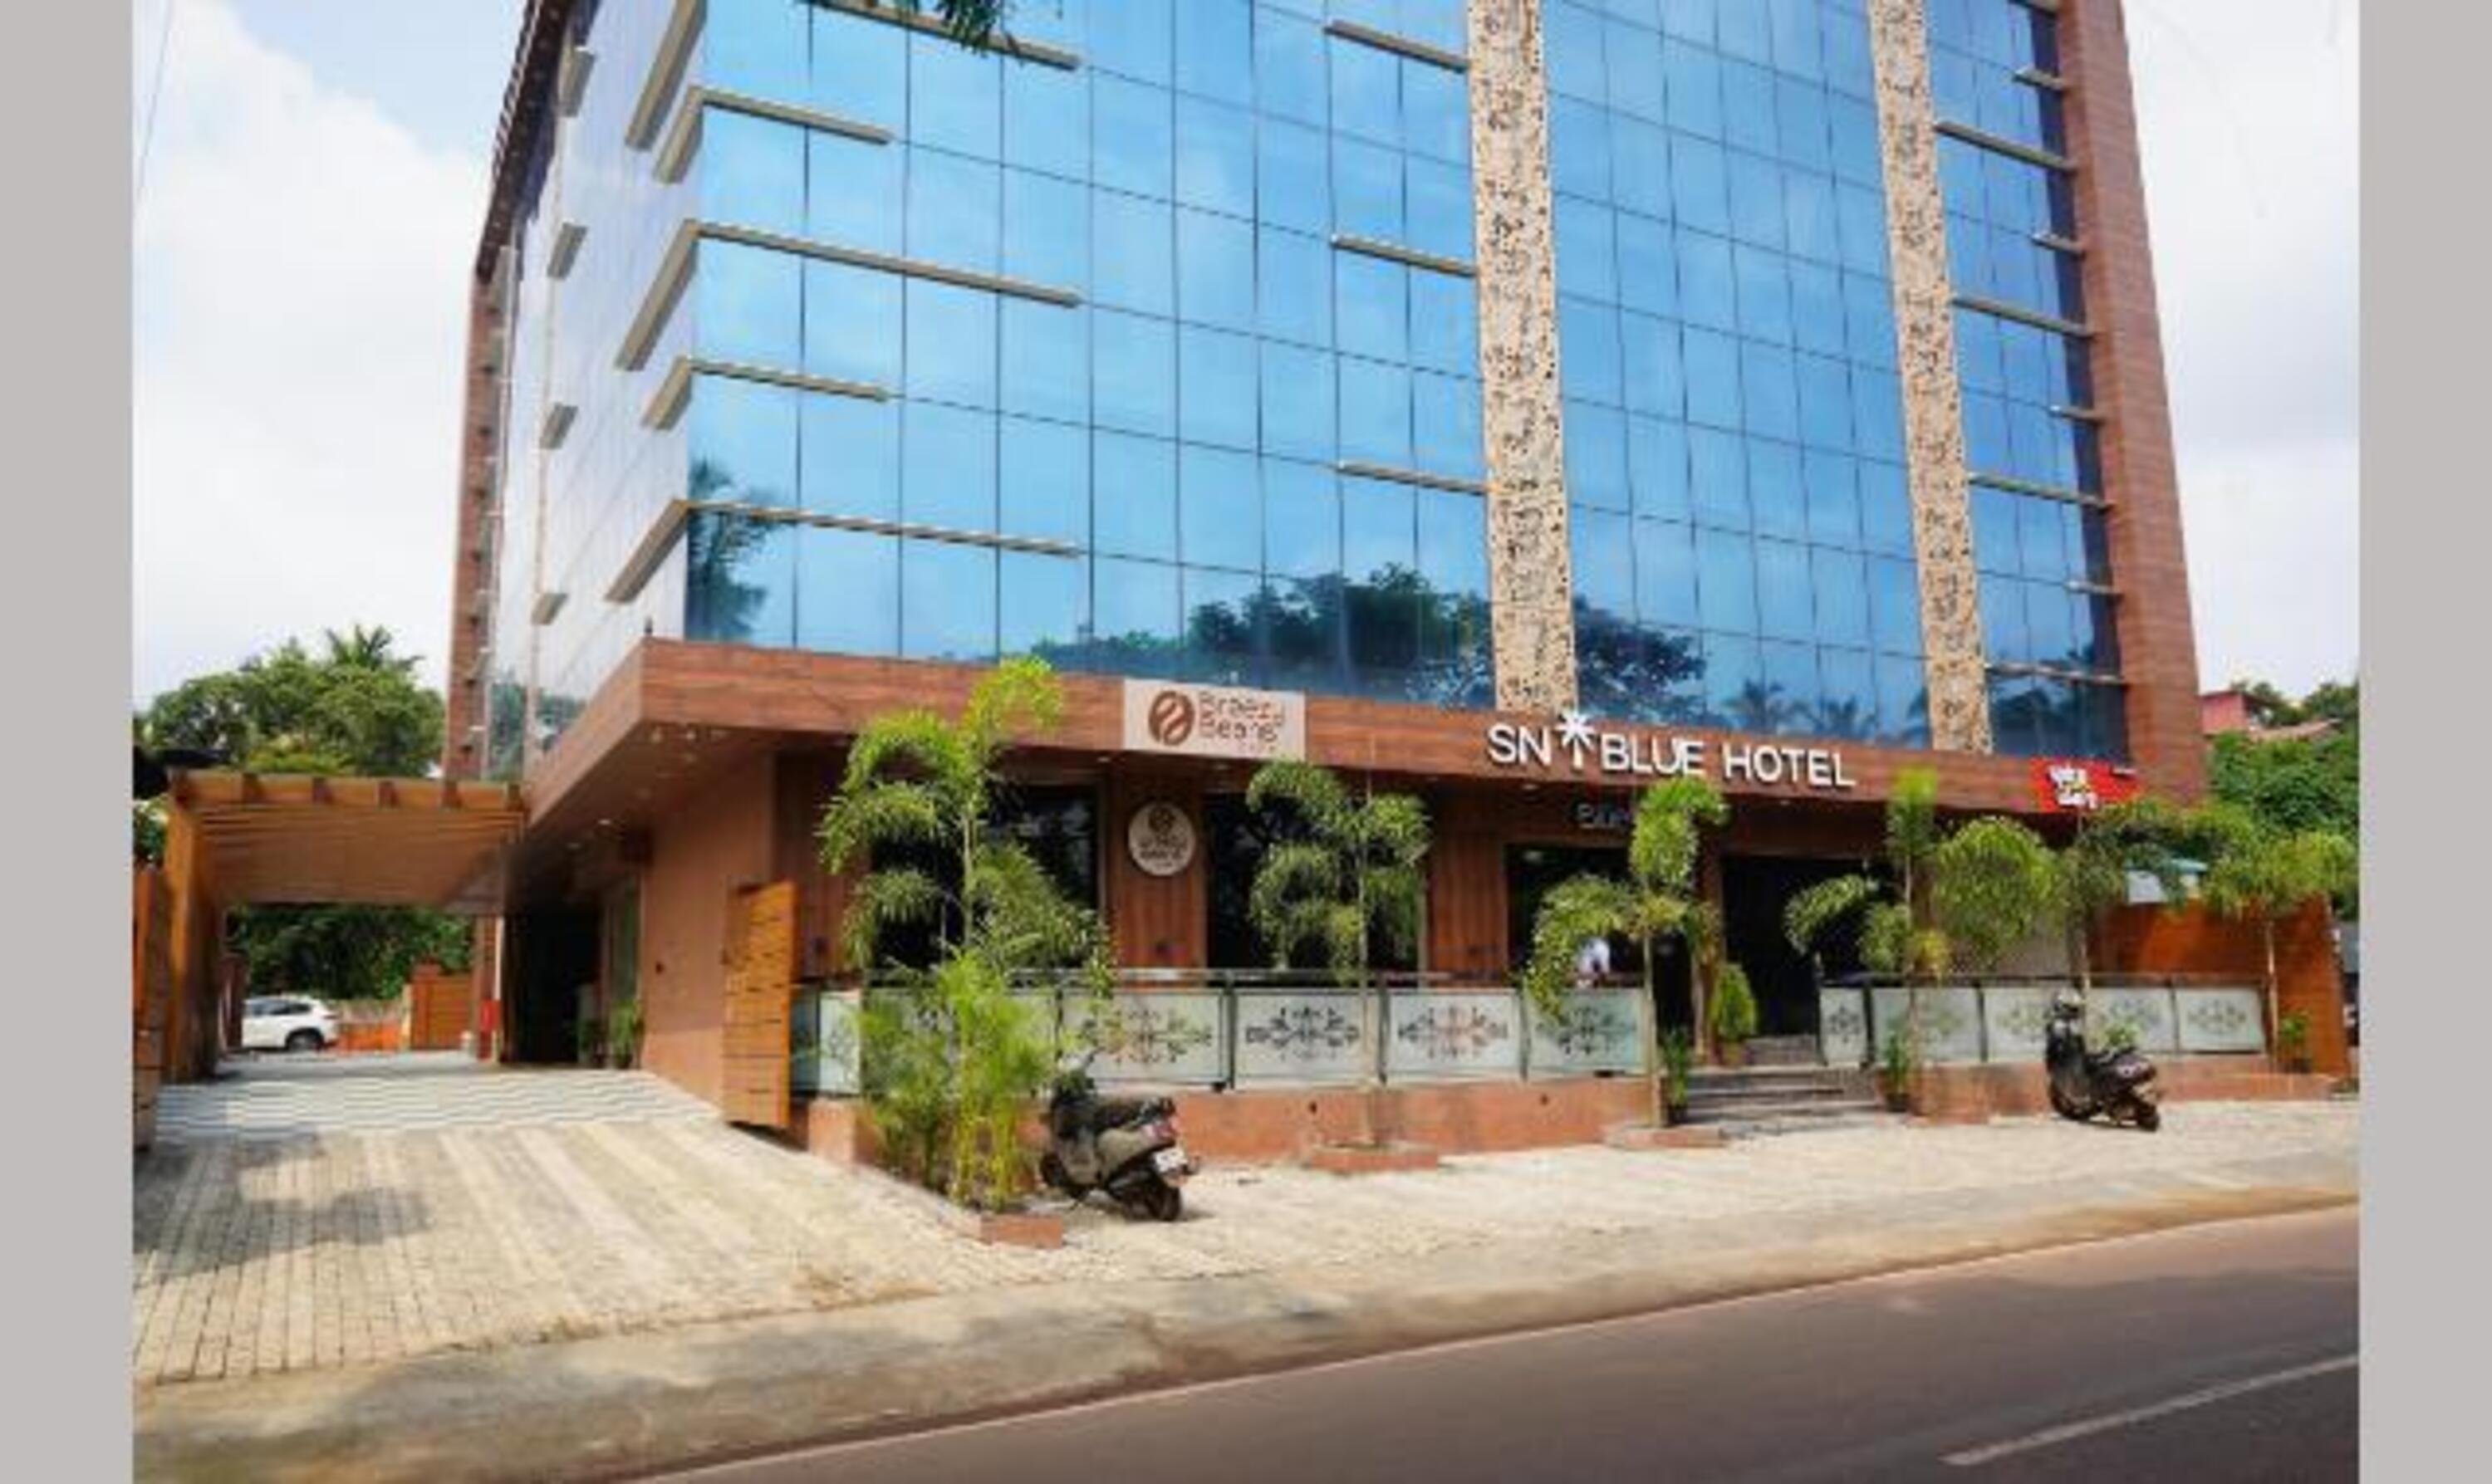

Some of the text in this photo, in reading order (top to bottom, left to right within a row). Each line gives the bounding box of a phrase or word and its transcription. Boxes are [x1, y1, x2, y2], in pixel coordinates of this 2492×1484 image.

[1199, 712, 1278, 742] Beans
[1488, 722, 1857, 787] SN BLUE HOTEL
